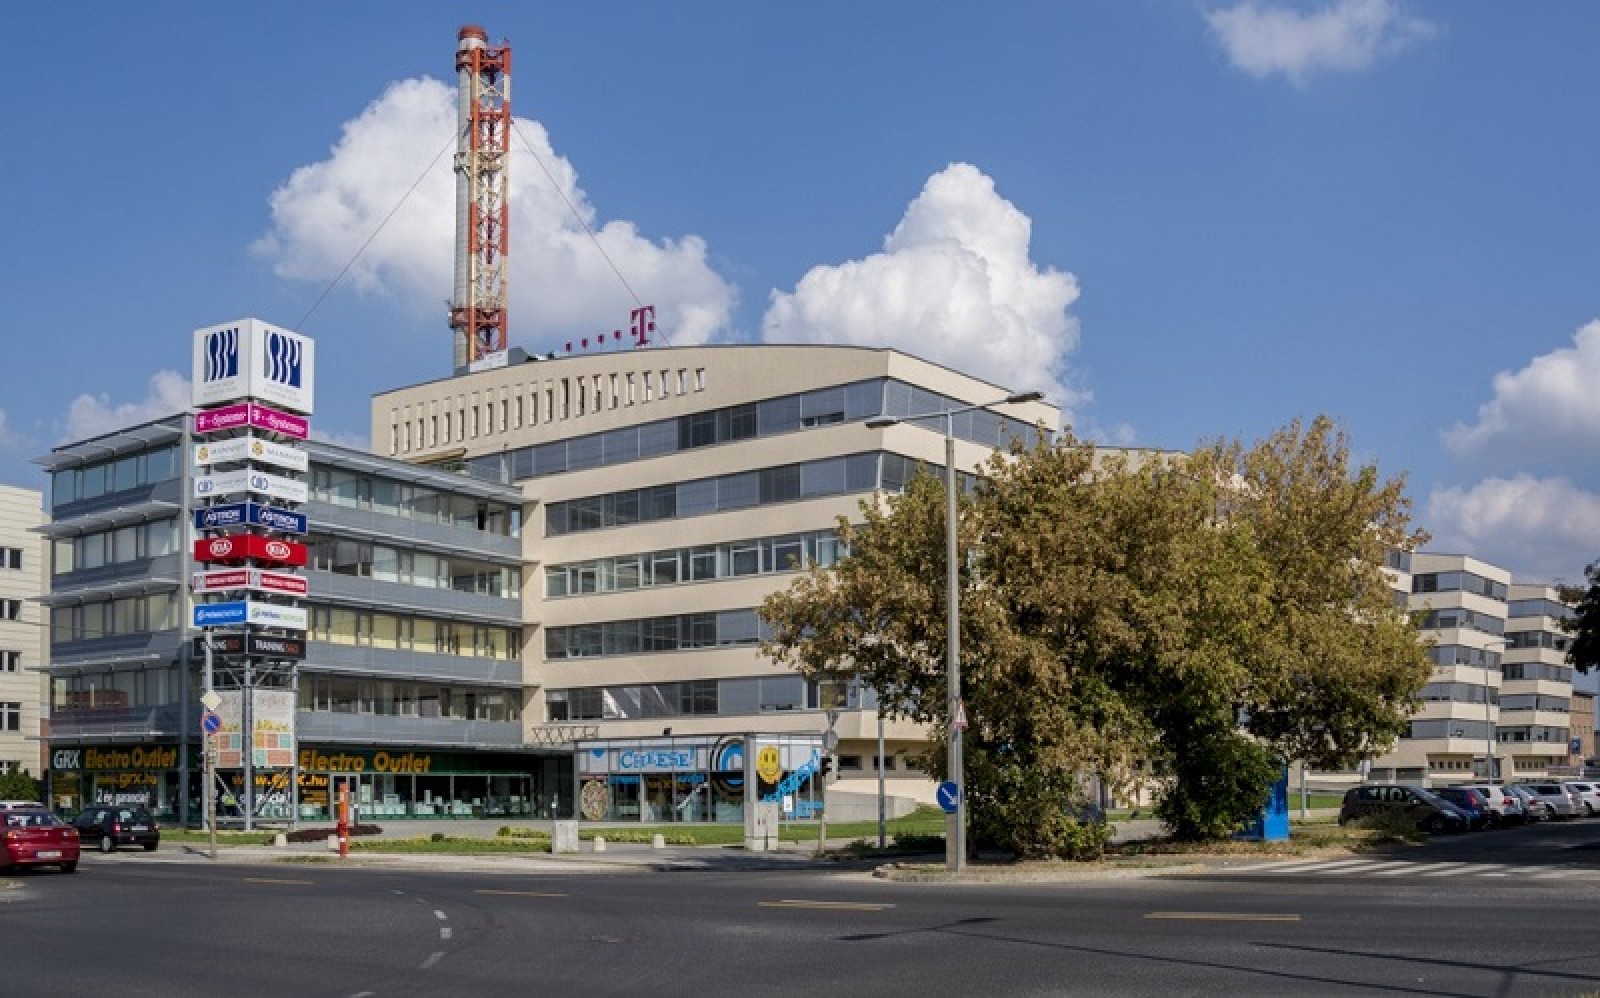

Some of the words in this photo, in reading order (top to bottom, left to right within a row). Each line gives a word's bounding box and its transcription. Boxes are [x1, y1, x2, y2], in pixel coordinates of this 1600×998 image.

[53, 749, 81, 769] GRX
[85, 747, 131, 769] Electro
[132, 745, 177, 769] Outlet
[299, 749, 365, 772] Electro
[373, 750, 432, 773] Outlet
